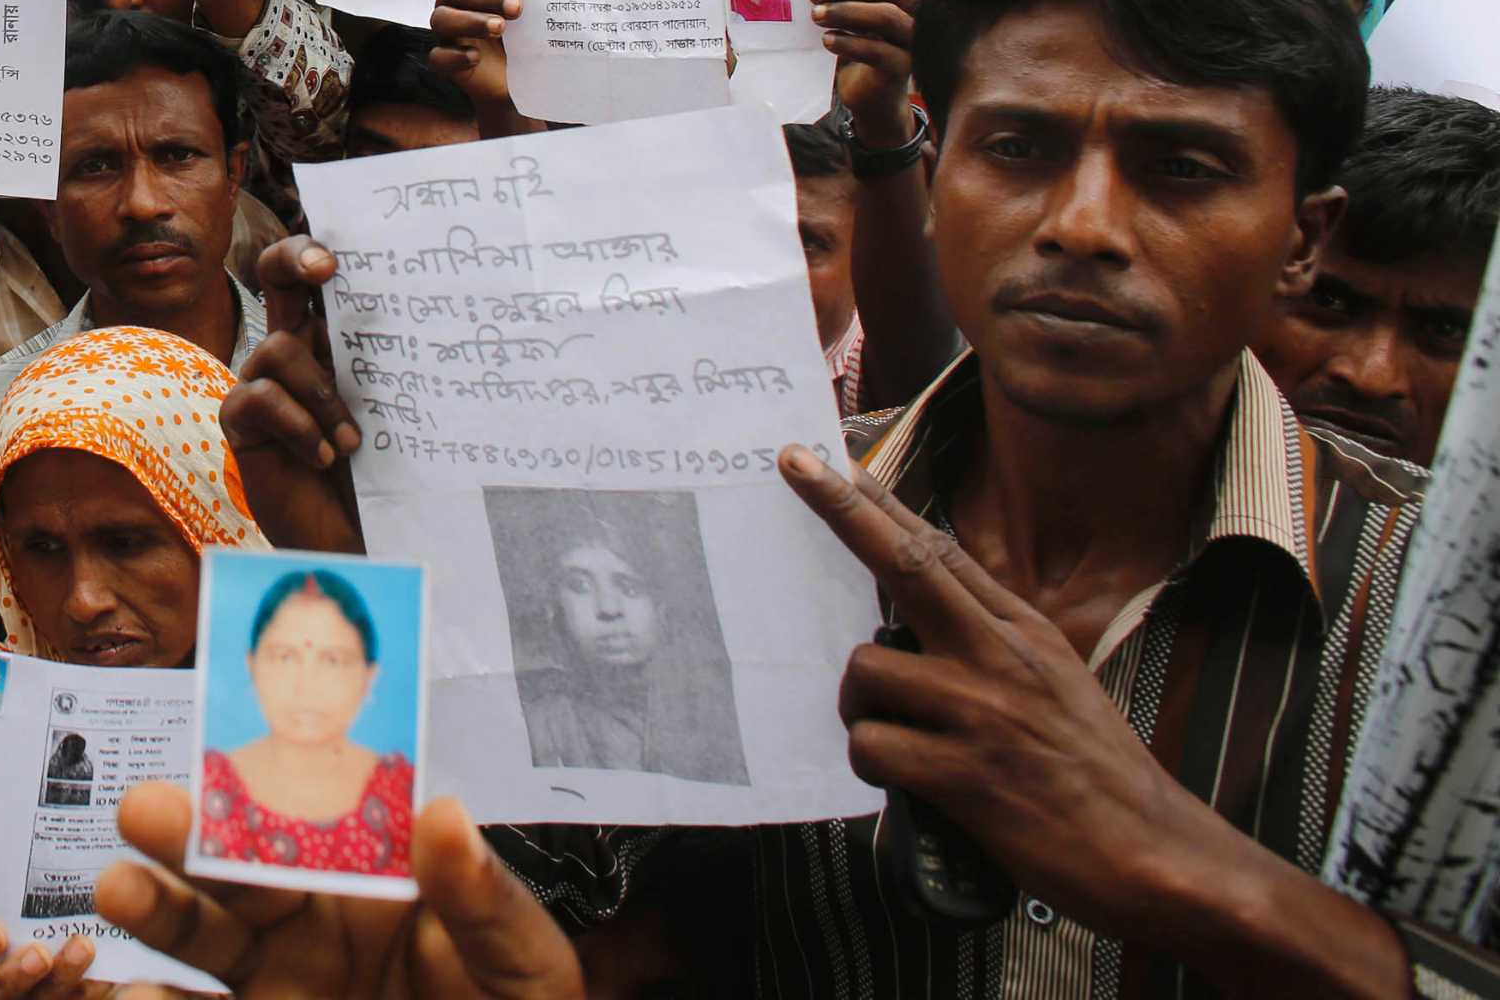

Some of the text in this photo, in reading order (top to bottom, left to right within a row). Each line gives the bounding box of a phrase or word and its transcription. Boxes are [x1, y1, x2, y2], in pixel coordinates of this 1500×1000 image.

[2, 4, 19, 46] রানায়
[373, 156, 555, 219] সন্ধান চাই
[330, 244, 399, 278] াম:
